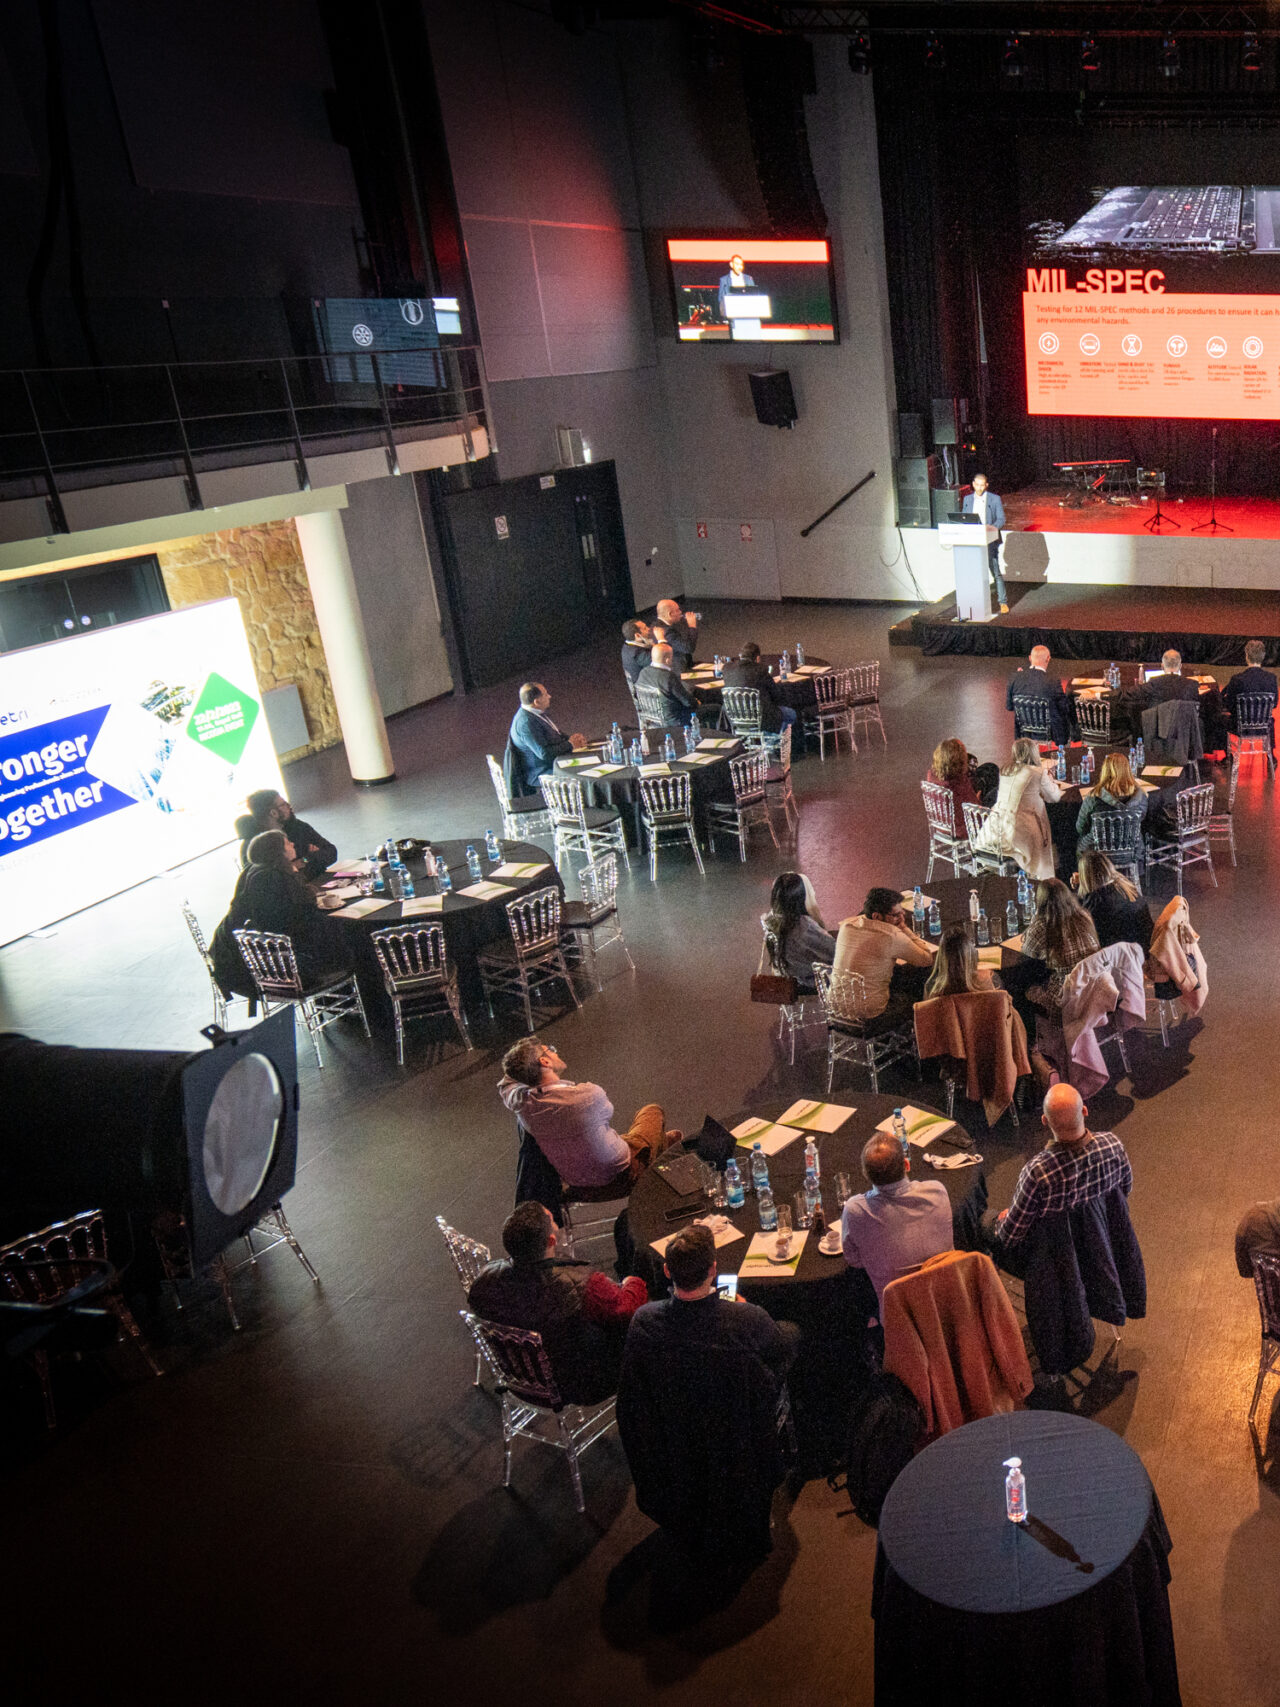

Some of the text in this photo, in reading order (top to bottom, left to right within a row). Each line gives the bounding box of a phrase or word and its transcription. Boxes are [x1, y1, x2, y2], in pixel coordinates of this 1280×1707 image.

[1026, 267, 1166, 294] MIL-SPEC
[1036, 305, 1061, 314] Testing
[1062, 305, 1073, 313] for
[1074, 305, 1083, 313] 12
[1119, 306, 1150, 314] methods
[1166, 307, 1175, 315] 26
[1176, 308, 1217, 316] procedures
[1253, 308, 1260, 316] it
[1050, 316, 1101, 324] environmental
[0, 734, 89, 786] onger
